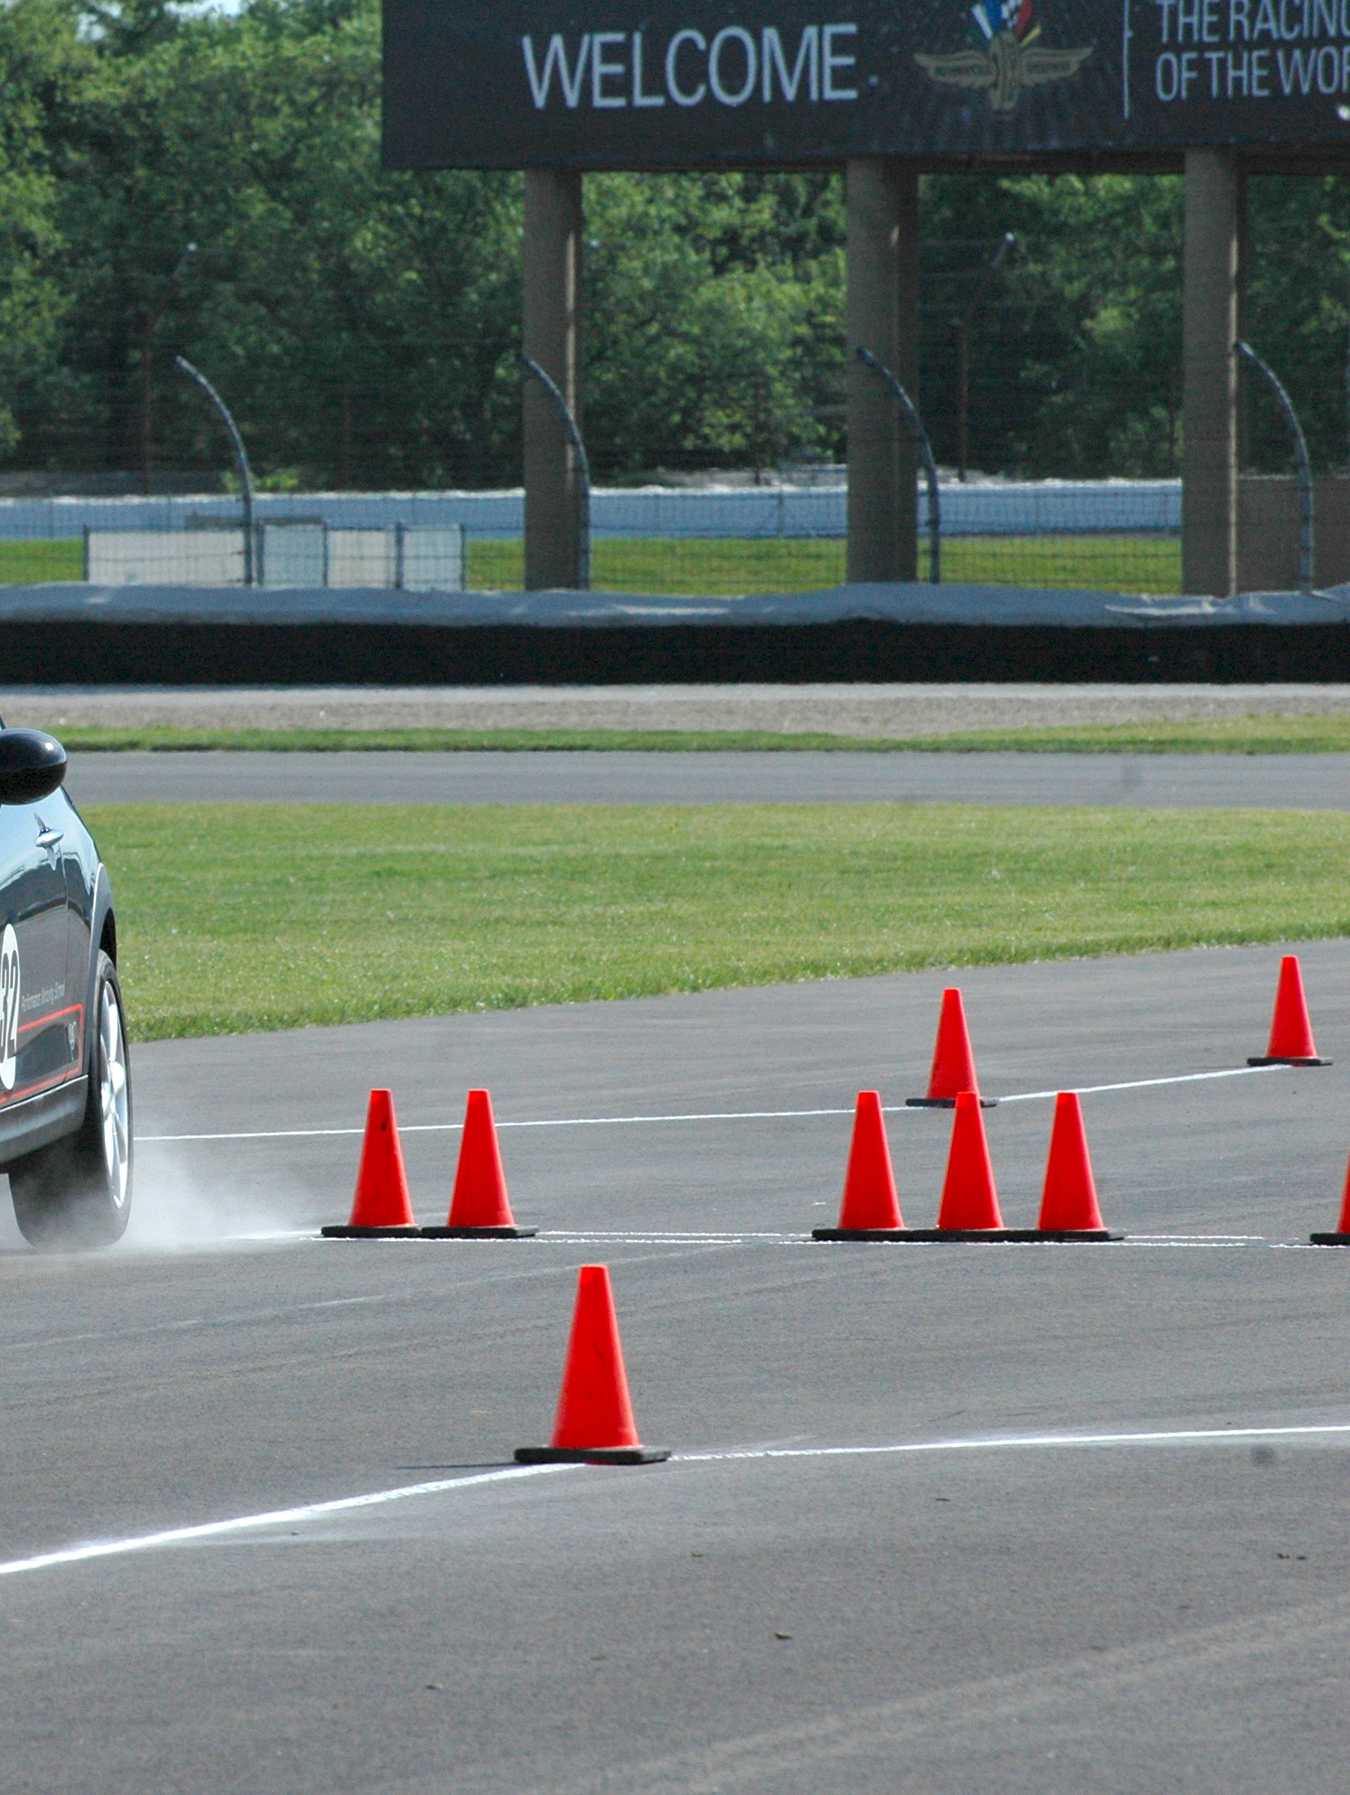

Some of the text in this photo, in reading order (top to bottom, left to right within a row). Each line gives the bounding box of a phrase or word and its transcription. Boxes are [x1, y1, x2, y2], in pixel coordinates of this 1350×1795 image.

[1156, 0, 1220, 43] THE
[521, 22, 859, 110] WELCOME
[1155, 52, 1199, 101] OF
[1203, 50, 1270, 99] THE
